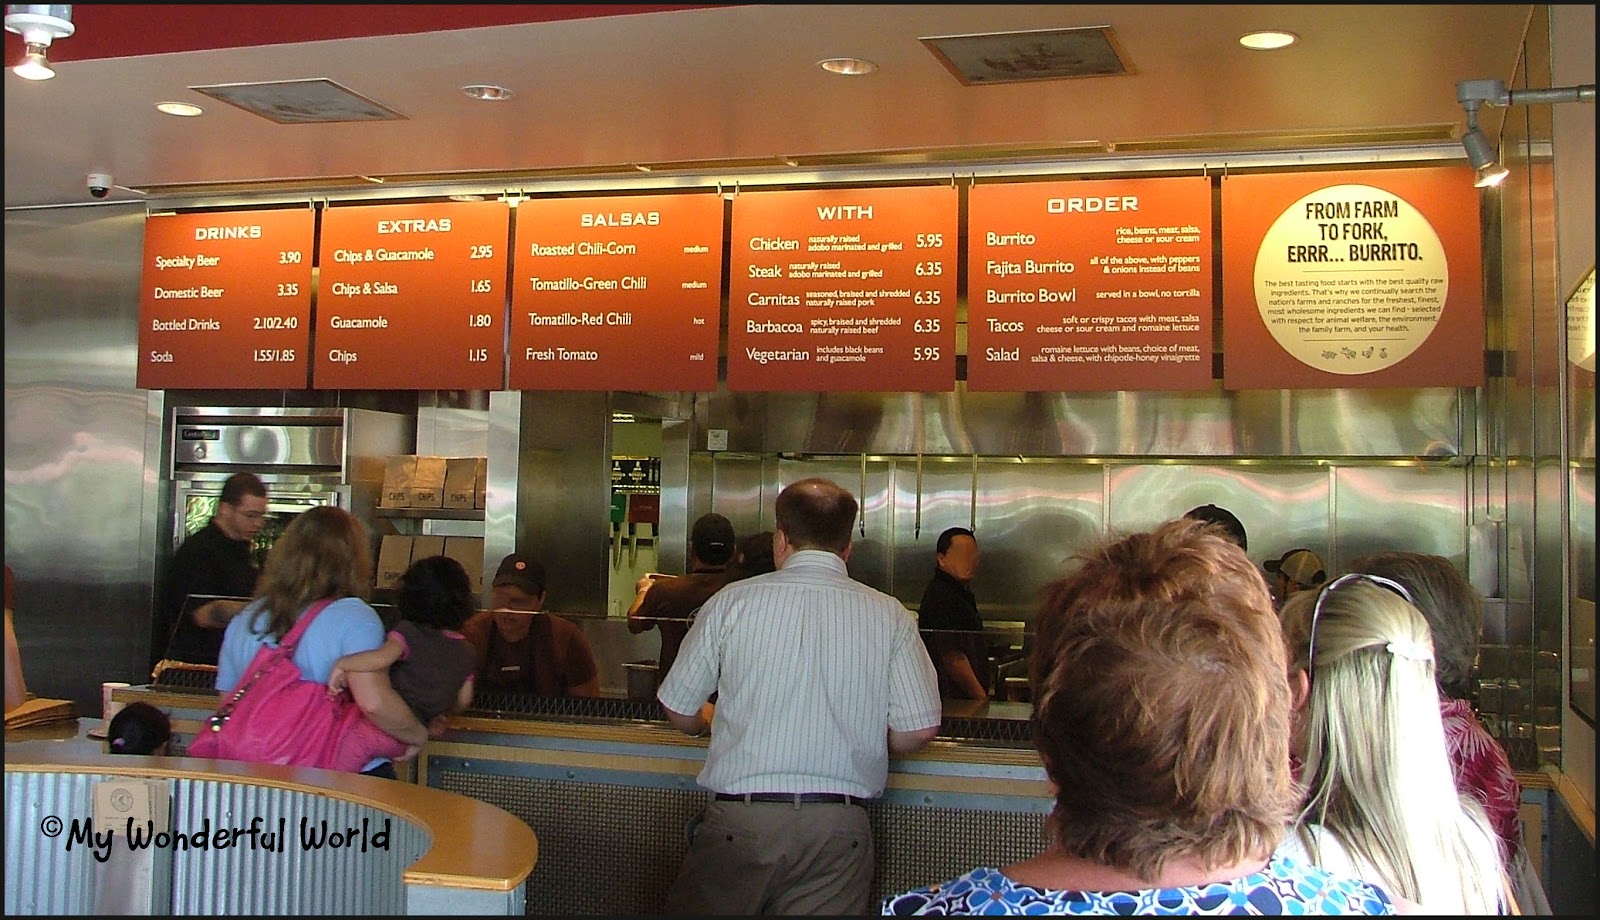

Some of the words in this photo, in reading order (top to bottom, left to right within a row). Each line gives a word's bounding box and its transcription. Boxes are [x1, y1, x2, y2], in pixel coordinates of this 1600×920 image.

[1048, 197, 1138, 213] ORDER
[1307, 202, 1350, 219] FROM
[1355, 201, 1398, 218] FARM
[581, 212, 659, 227] SALSAS
[818, 206, 872, 220] WITH
[378, 219, 451, 233] EXTRAS
[1318, 224, 1338, 240] TO
[1343, 222, 1387, 241] FORK,
[196, 226, 261, 240] DRINKS
[987, 232, 1035, 245] Burrito
[750, 237, 799, 250] Chicken
[917, 234, 942, 247] 5.95
[1117, 236, 1143, 244] cheese
[471, 246, 492, 258] 2.95
[532, 243, 574, 256] Roasted
[578, 242, 636, 255] Chili-Corn
[1288, 245, 1344, 263] ERRR...
[1350, 243, 1422, 262] BURRITO.
[156, 255, 195, 270] Specialty
[197, 254, 220, 266] Beer
[280, 252, 301, 264] 3.90
[335, 249, 363, 264] Chips
[365, 250, 374, 261] &
[376, 248, 434, 261] Guacamole
[1100, 256, 1109, 264] of
[1110, 256, 1123, 264] the
[749, 265, 782, 278] Steak
[916, 262, 942, 276] 6.35
[988, 261, 1022, 278] Fajita
[1026, 260, 1074, 273] Burrito
[1103, 266, 1110, 274] &
[1139, 264, 1166, 273] instead
[1168, 264, 1177, 272] of
[1178, 264, 1200, 272] beans
[278, 284, 298, 296] 3.35
[332, 283, 361, 297] Chips
[363, 283, 371, 294] &
[374, 282, 398, 294] Salsa
[472, 280, 491, 292] 1.65
[530, 277, 617, 290] Tomatillo-Green
[622, 277, 646, 289] Chili
[155, 287, 199, 299] Domestic
[201, 286, 224, 298] Beer
[748, 293, 800, 305] Carnitas
[915, 291, 940, 304] 6.35
[987, 290, 1035, 303] Burrito
[1039, 288, 1075, 302] Bowl
[1096, 290, 1122, 298] served
[1174, 289, 1200, 297] tortilla
[806, 299, 834, 308] naturally
[836, 298, 856, 306] raised
[858, 299, 875, 307] pork
[153, 319, 186, 331] Bottled
[189, 319, 220, 330] Drinks
[254, 317, 297, 329] 2.10/2.40
[331, 316, 388, 328] Guacamole
[470, 315, 491, 327] 1.80
[528, 313, 603, 325] Tomatillo-Red
[607, 312, 631, 325] Chili
[855, 318, 868, 326] and
[987, 318, 1024, 332] Tacos
[1063, 316, 1078, 324] soft
[1092, 316, 1114, 324] crispy
[747, 320, 803, 333] Barbacoa
[810, 326, 839, 336] naturally
[841, 326, 861, 334] raised
[863, 326, 878, 334] beef
[914, 319, 940, 332] 6.35
[1037, 325, 1063, 333] cheese
[1096, 324, 1120, 332] cream
[1122, 324, 1136, 332] and
[1172, 323, 1200, 331] lettuce
[151, 351, 173, 362] Soda
[255, 350, 294, 361] 1.55/1.85
[329, 350, 357, 364] Chips
[470, 350, 487, 361] 1.15
[526, 348, 554, 360] Fresh
[557, 348, 598, 360] Tomato
[746, 348, 809, 363] Vegetarian
[830, 354, 866, 362] guacamole
[914, 348, 939, 360] 5.95
[986, 348, 1019, 361] Salad
[1086, 354, 1102, 362] with
[1104, 354, 1159, 363] chipotle-honey
[1161, 354, 1200, 363] vinaigrette
